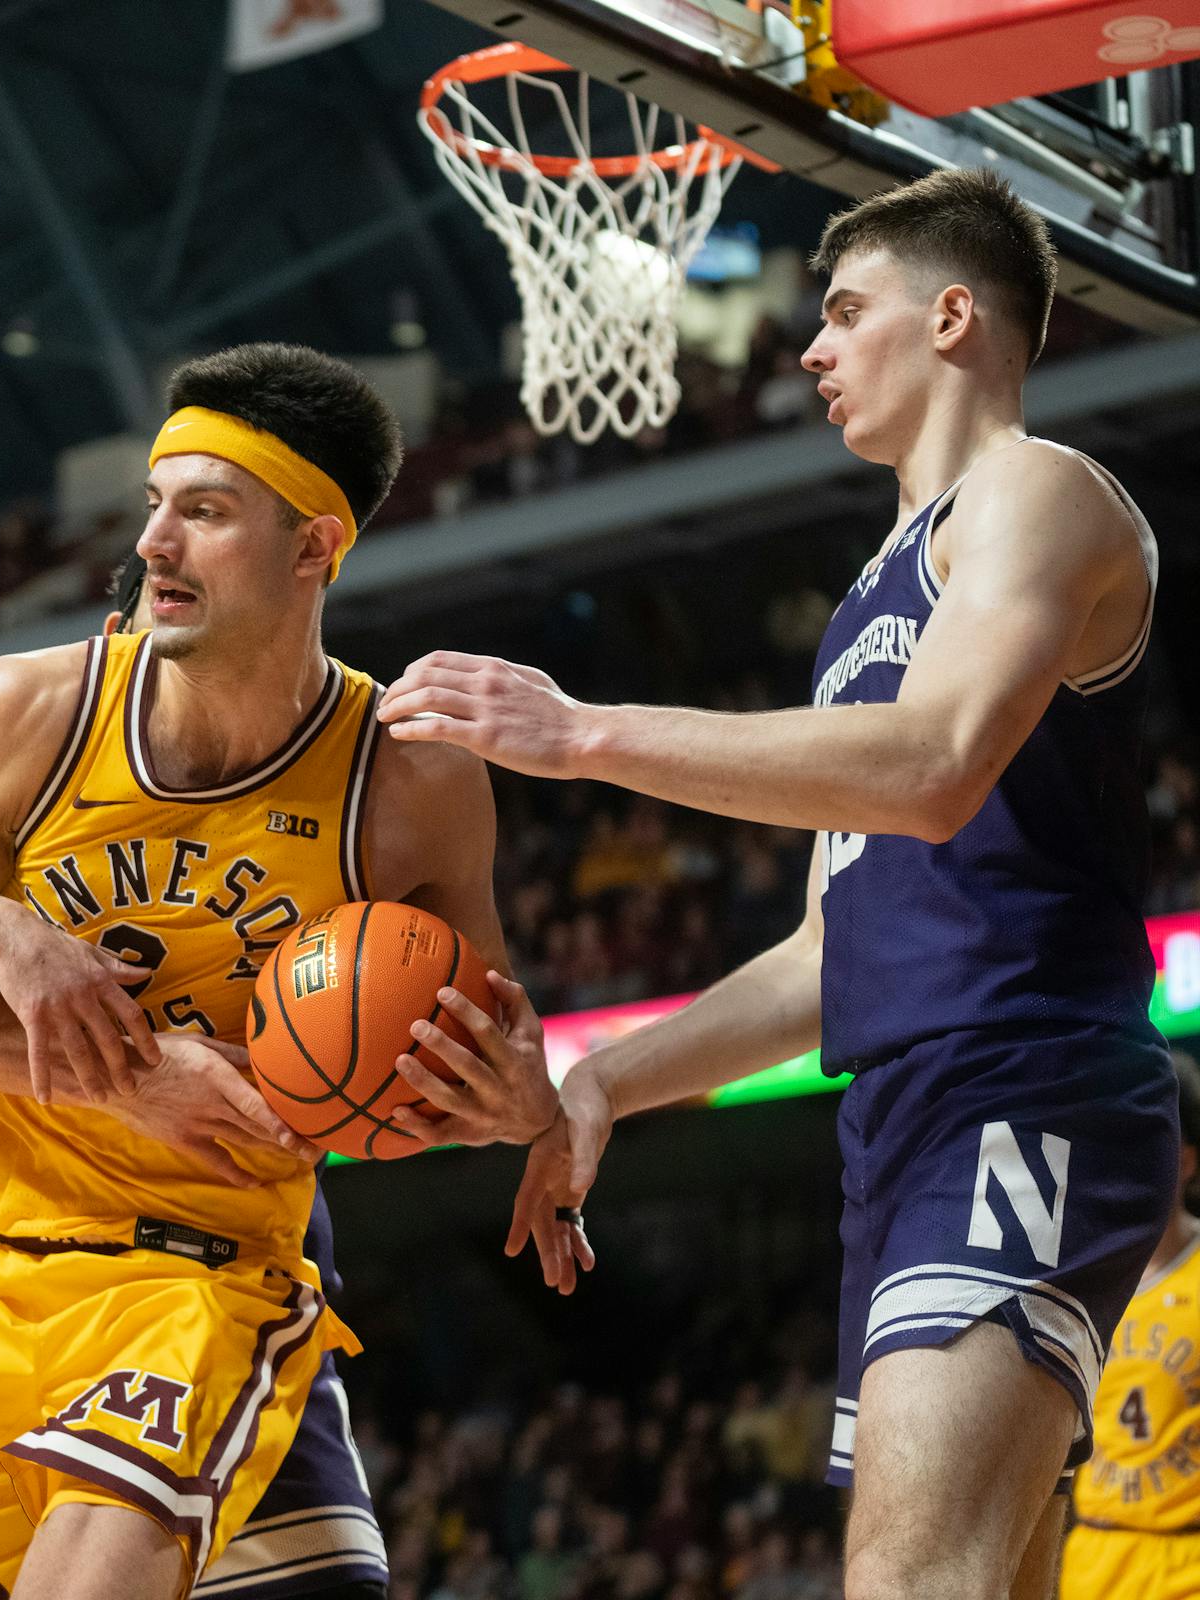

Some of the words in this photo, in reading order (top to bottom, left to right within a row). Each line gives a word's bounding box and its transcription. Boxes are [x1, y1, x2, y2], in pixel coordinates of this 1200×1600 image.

[966, 1119, 1071, 1269] N
[211, 1240, 230, 1255] 50
[55, 1368, 194, 1454] M
[1118, 1385, 1150, 1440] 4
